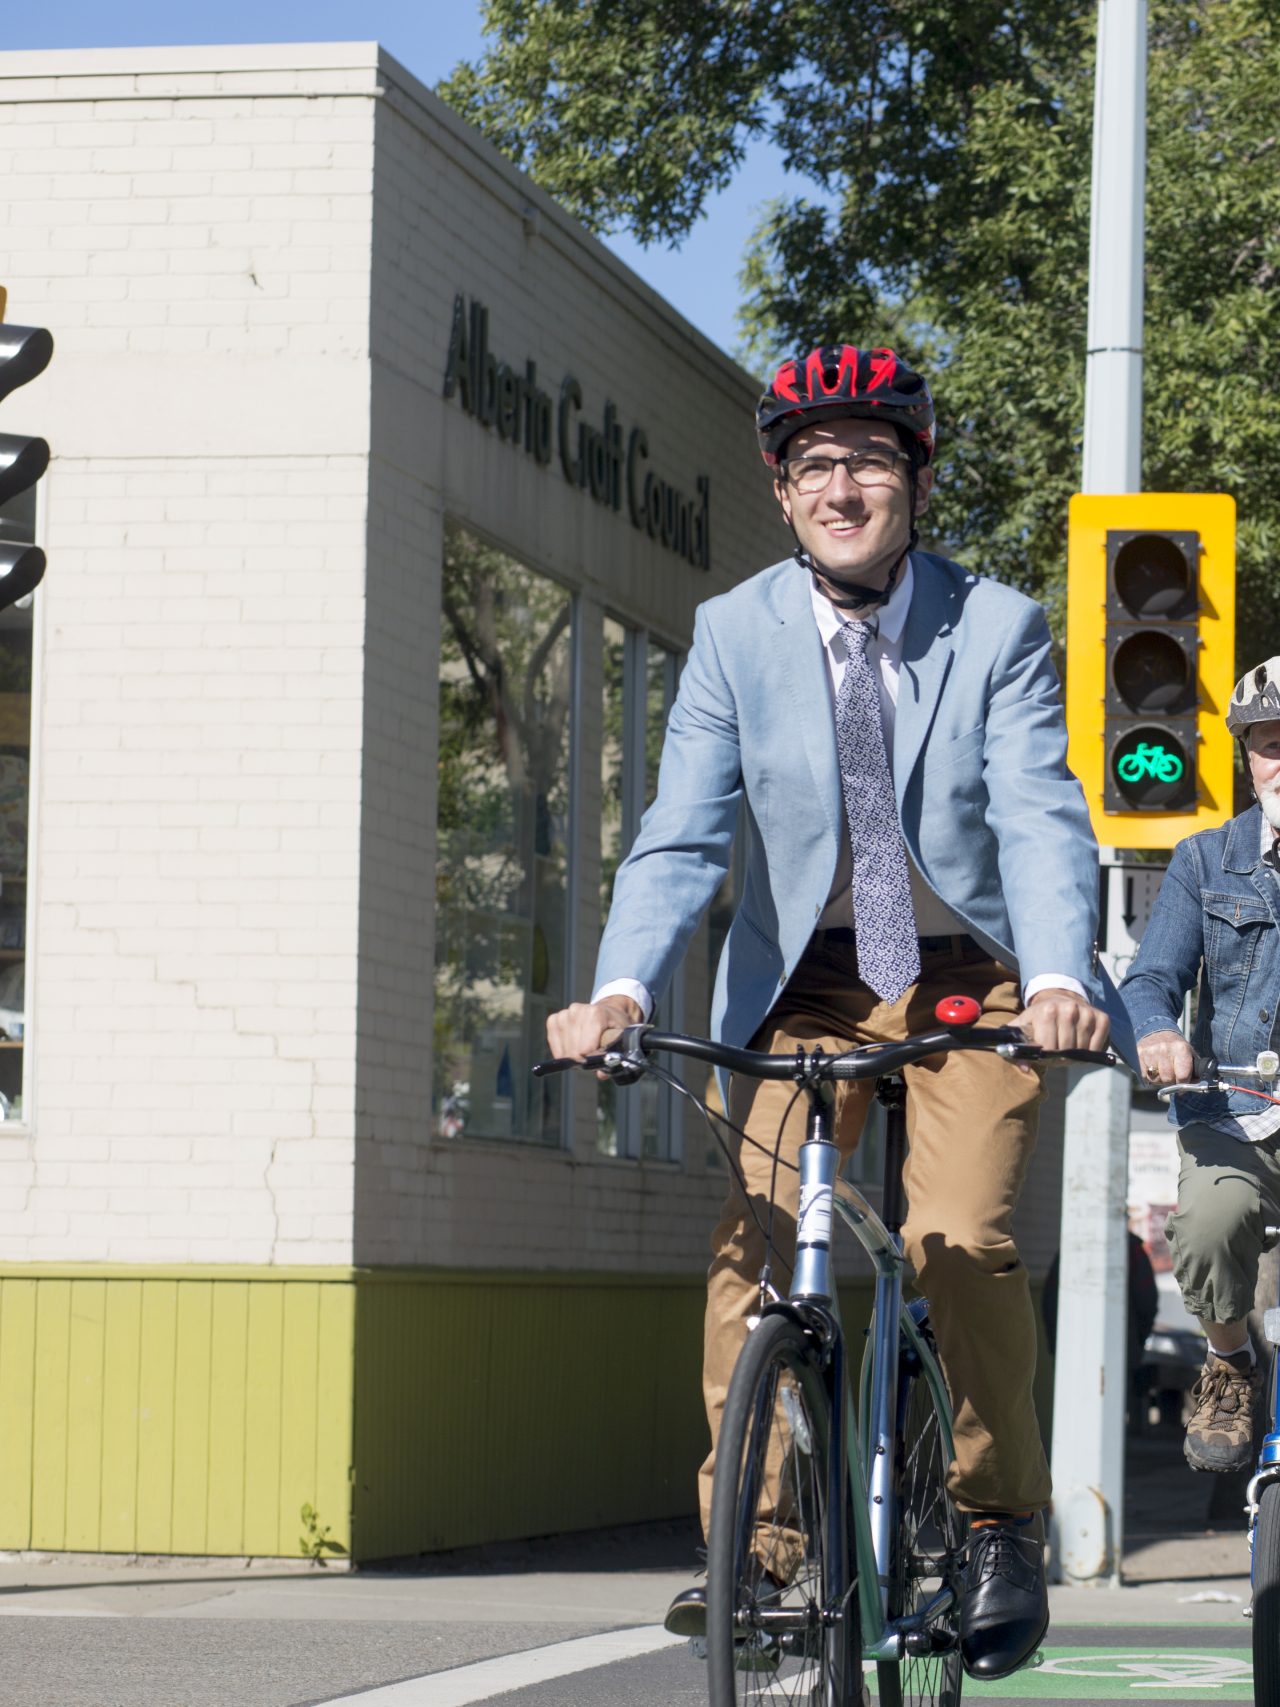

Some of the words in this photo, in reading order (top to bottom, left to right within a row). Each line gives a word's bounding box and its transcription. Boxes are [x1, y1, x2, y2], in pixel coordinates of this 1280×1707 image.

[443, 293, 553, 466] Alberta
[559, 374, 625, 514] Craft
[627, 426, 711, 571] Council
